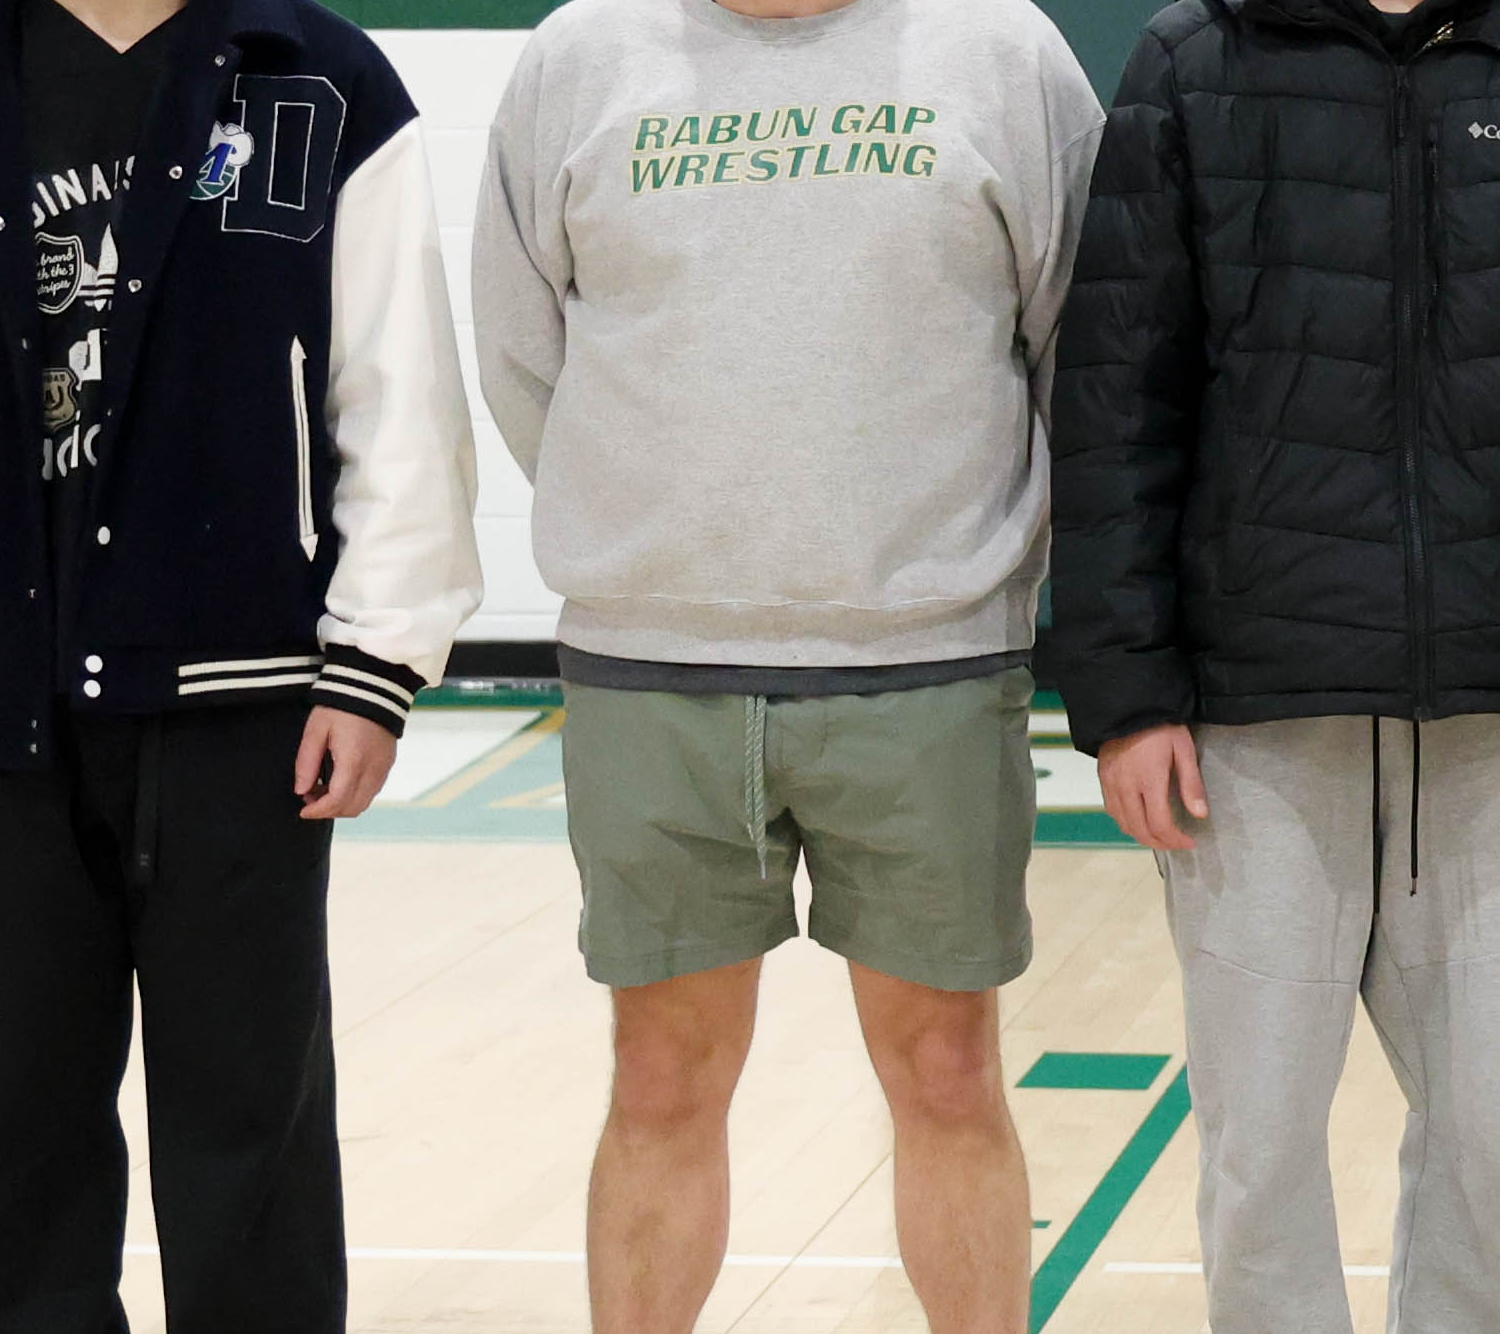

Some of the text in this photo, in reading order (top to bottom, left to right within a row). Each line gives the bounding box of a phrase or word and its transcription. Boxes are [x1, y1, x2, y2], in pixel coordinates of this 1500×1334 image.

[634, 103, 938, 152] RABUN GAP
[629, 141, 939, 196] WRESTLING
